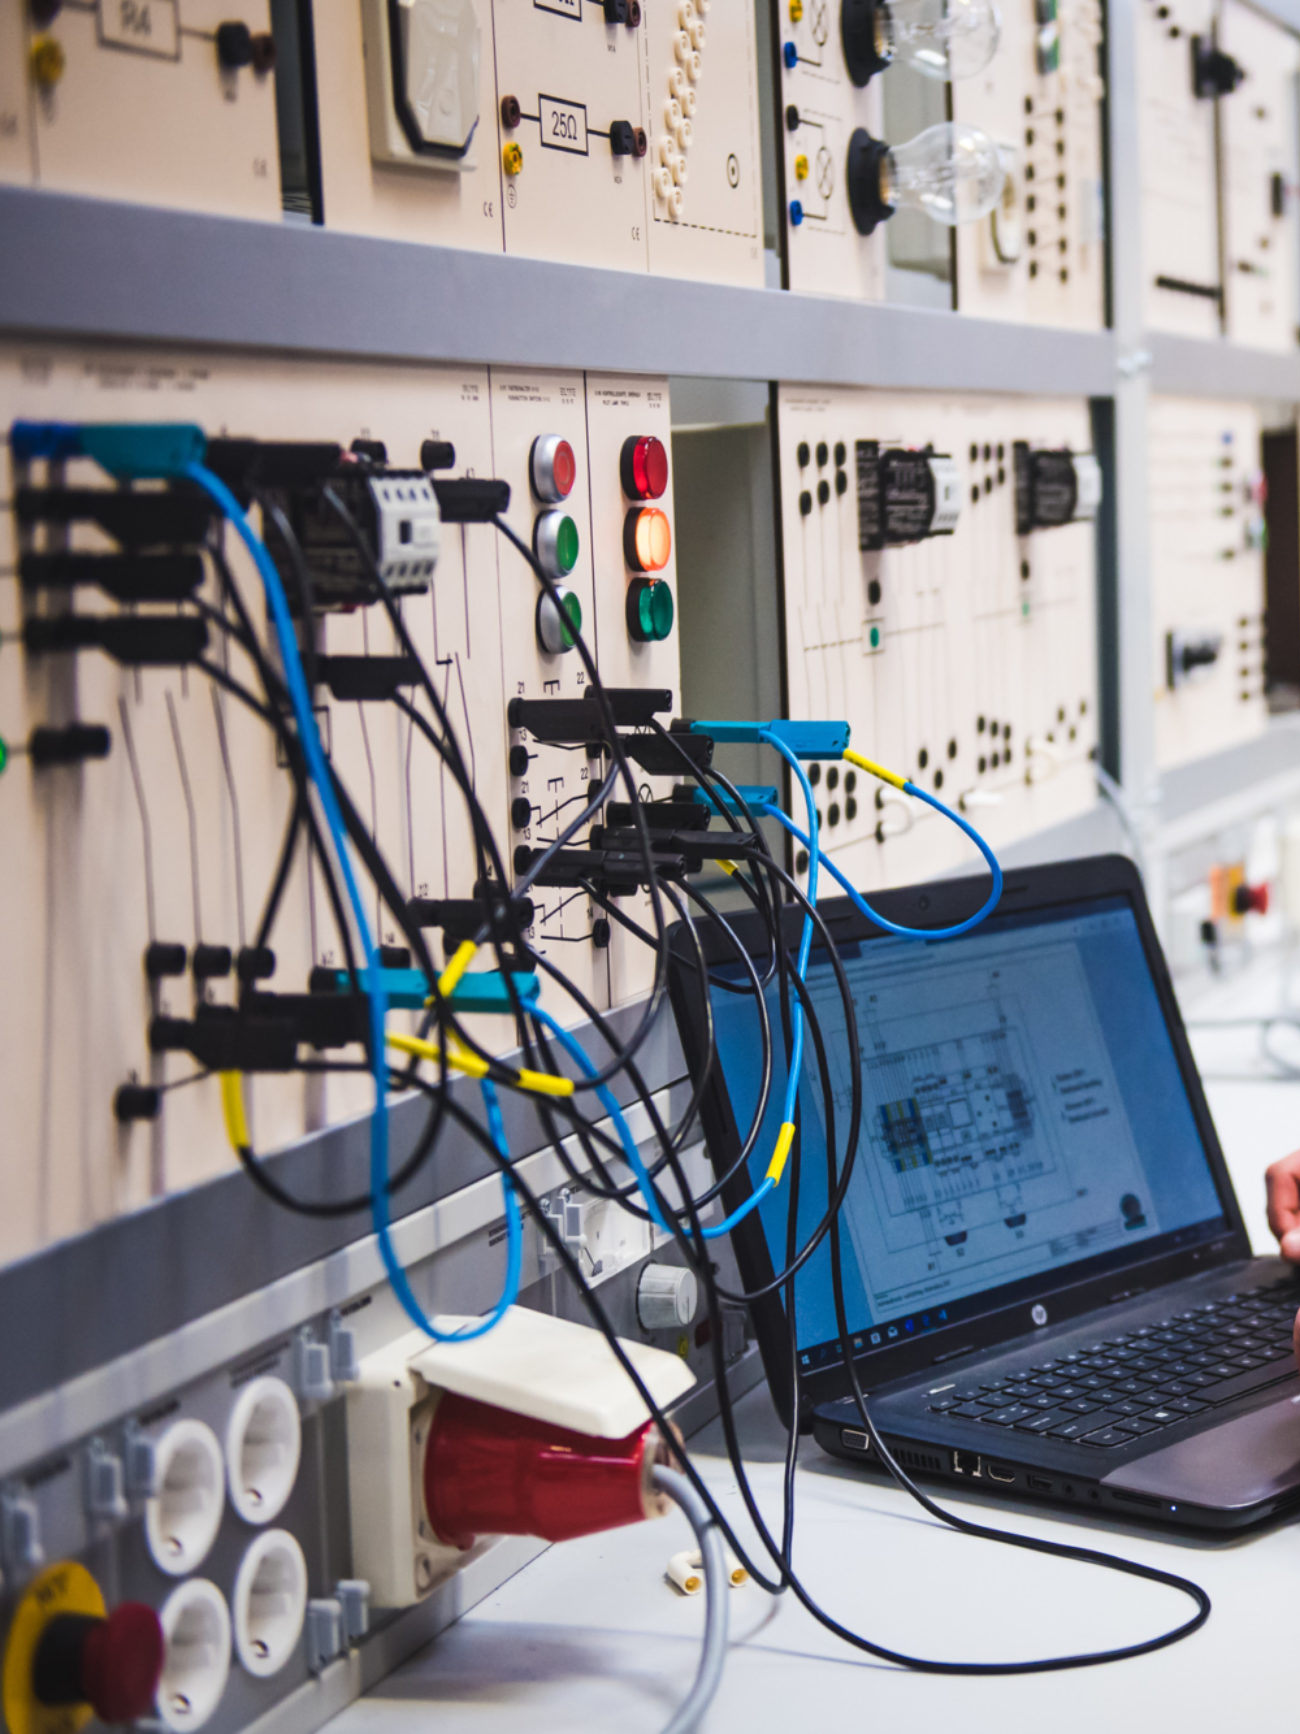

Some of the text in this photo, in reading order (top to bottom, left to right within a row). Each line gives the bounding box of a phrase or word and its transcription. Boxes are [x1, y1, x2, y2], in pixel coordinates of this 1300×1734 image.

[552, 110, 577, 140] 25Ω
[576, 671, 585, 685] 22
[517, 680, 525, 695] 21
[580, 767, 588, 780] 22
[521, 780, 529, 794] 21
